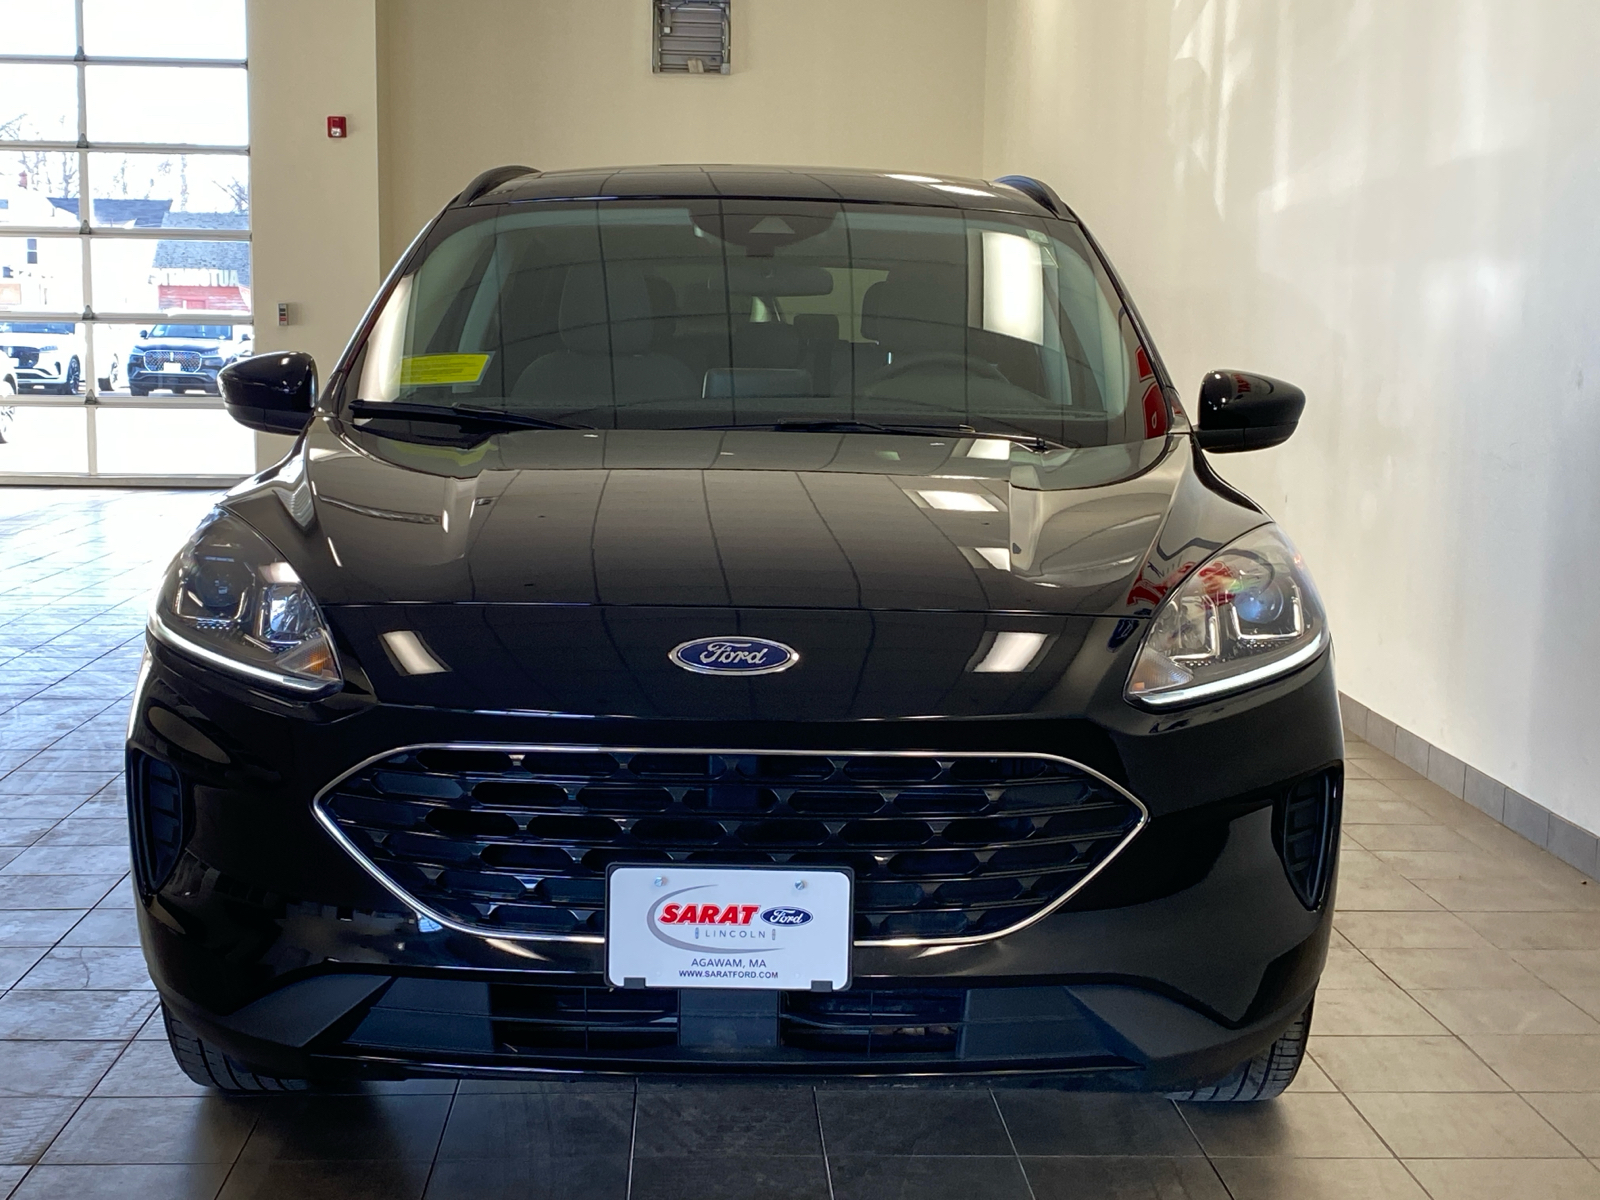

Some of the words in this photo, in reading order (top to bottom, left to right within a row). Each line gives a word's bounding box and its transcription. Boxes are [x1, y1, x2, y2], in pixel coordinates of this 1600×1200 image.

[699, 641, 768, 664] Ford
[658, 902, 761, 926] SARAT
[770, 909, 803, 924] Ford
[705, 929, 766, 939] LINCOLN
[690, 958, 746, 969] AGAWAM,
[748, 959, 767, 968] MA
[678, 970, 779, 979] WWW.SARATFORD.COM
